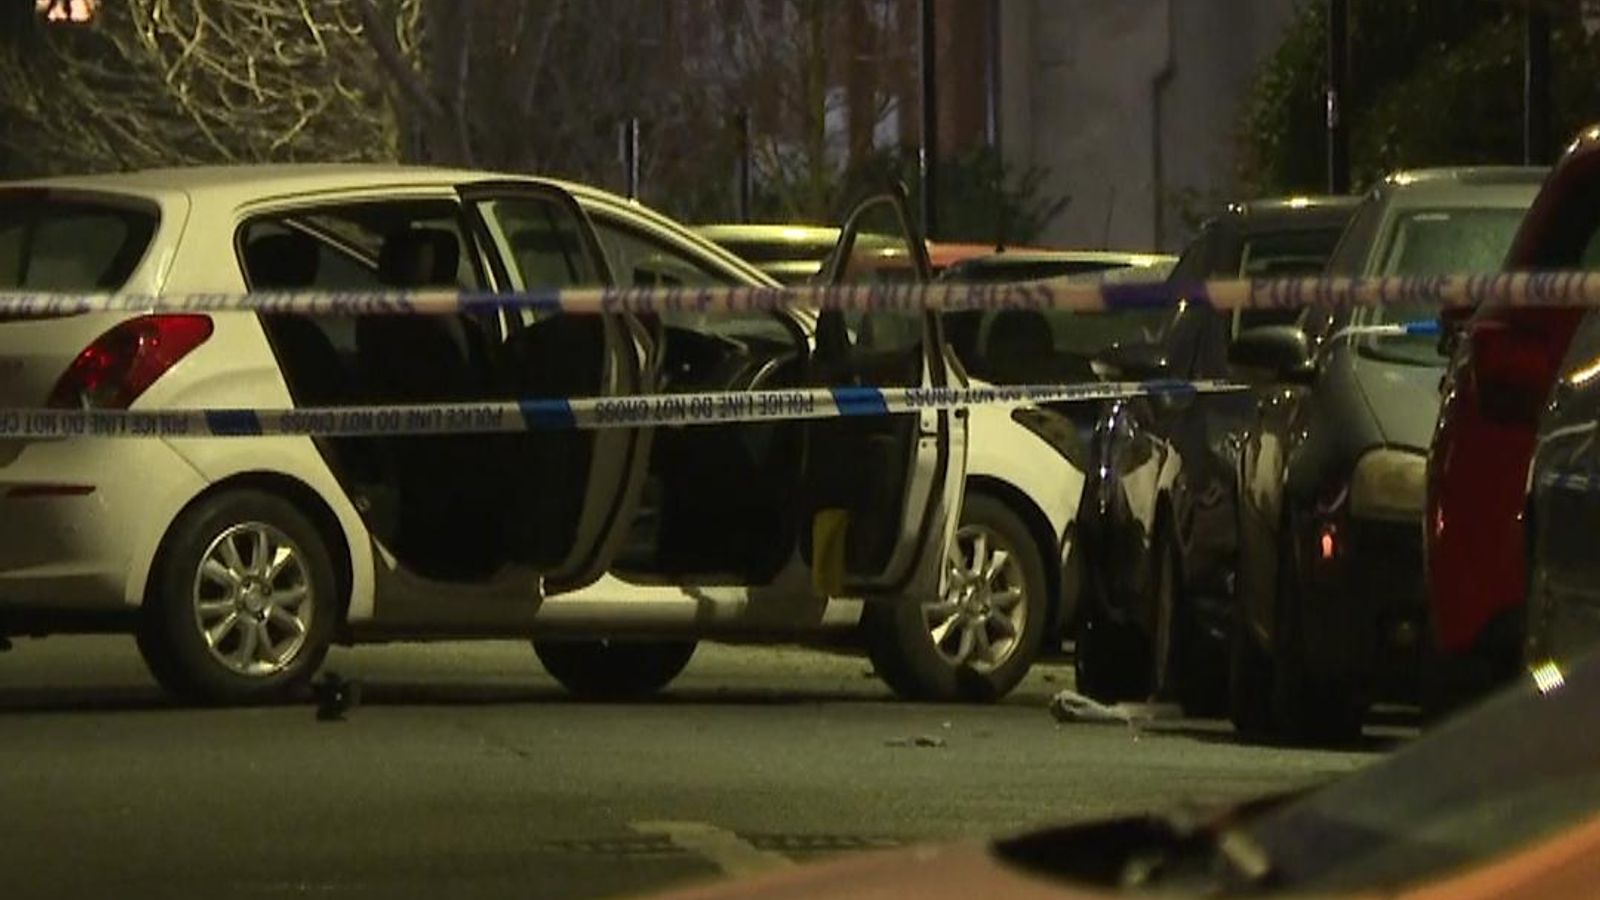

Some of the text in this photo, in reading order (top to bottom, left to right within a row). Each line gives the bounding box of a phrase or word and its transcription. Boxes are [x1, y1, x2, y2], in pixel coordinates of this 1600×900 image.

[594, 392, 814, 423] POLICE LINE DO NOT CROSS
[904, 388, 957, 407] CROSS
[963, 387, 995, 404] NOT
[24, 411, 57, 433] NOT
[61, 411, 85, 433] DO
[279, 405, 504, 433] POLICE LINE DO NOT CROSS
